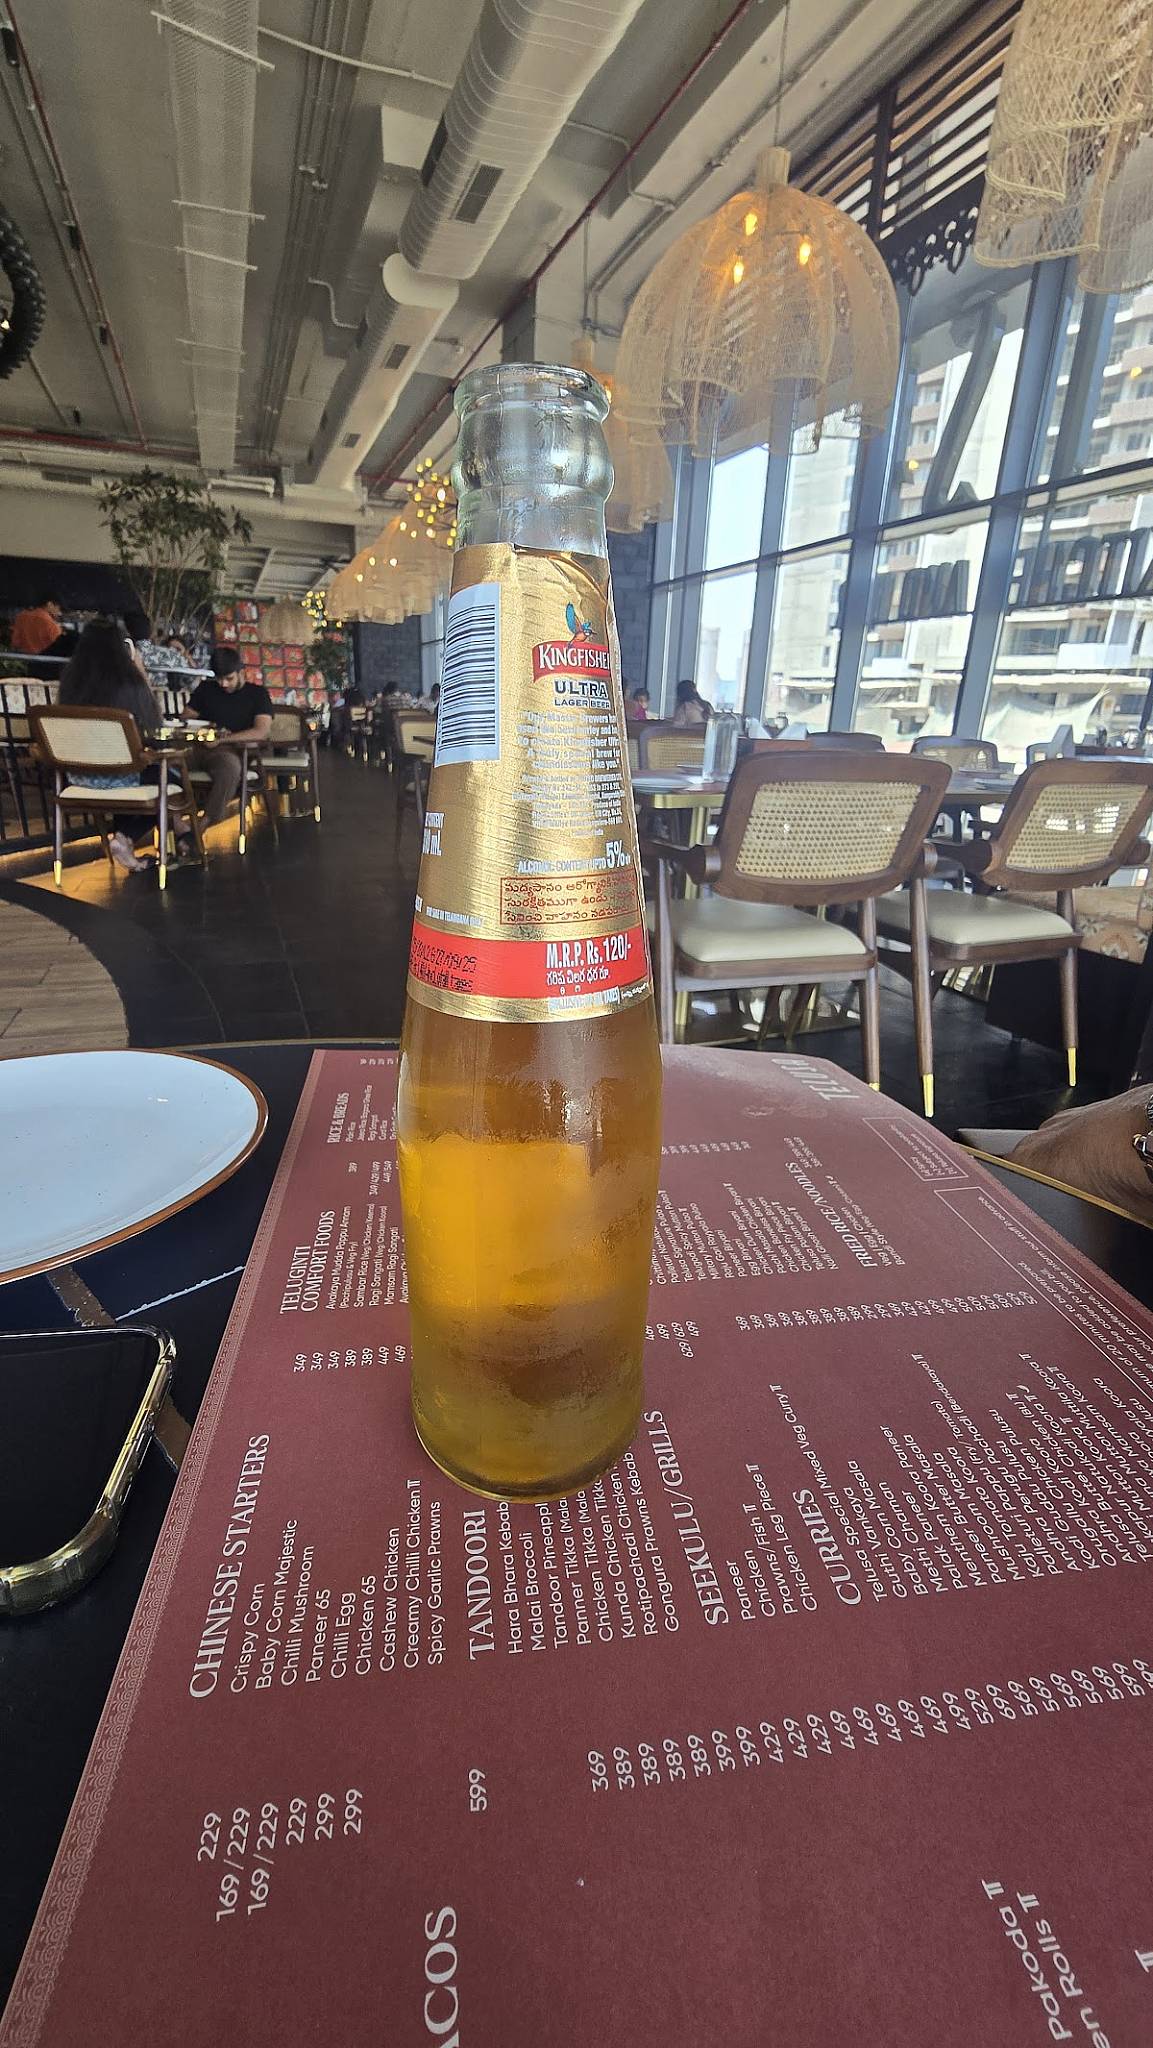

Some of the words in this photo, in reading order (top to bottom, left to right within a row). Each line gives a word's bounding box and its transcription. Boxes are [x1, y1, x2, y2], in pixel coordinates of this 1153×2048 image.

[554, 680, 608, 698] ULTRA
[554, 699, 588, 707] LAGER
[590, 700, 610, 709] BEER
[546, 942, 584, 968] M.R.P.
[586, 940, 603, 965] Rs.
[603, 933, 632, 961] 120/-
[331, 1118, 345, 1126] &
[332, 1092, 350, 1119] BREADS
[327, 1125, 343, 1144] RICE
[787, 1162, 851, 1233] RICE/NOODLES
[313, 1210, 336, 1248] FOODS
[841, 1234, 877, 1268] FRIED
[279, 1245, 312, 1315] TELUGINTI
[300, 1248, 329, 1312] COMFORT
[357, 1260, 369, 1276] Rice
[370, 1258, 385, 1288] Sangati
[353, 1276, 367, 1308] Sambar
[368, 1288, 383, 1307] Ragi
[901, 1301, 919, 1317] 429
[954, 1296, 974, 1313] 509
[1053, 1293, 1067, 1304] be
[1064, 1304, 1076, 1313] to
[671, 1322, 694, 1358] 629/629
[735, 1315, 751, 1331] 369
[791, 1310, 808, 1327] 389
[1074, 1313, 1110, 1344] minutes
[293, 1353, 308, 1373] 349
[310, 1352, 324, 1372] 349
[377, 1346, 390, 1365] 449
[1106, 1344, 1124, 1356] 20
[775, 1393, 797, 1423] Curry
[792, 1425, 810, 1449] Veg
[903, 1434, 940, 1480] Masala
[622, 1452, 644, 1496] Kebab
[802, 1450, 832, 1489] Mixed
[932, 1452, 972, 1500] Masala
[995, 1440, 1033, 1481] Pulusu
[752, 1473, 776, 1512] Piece
[847, 1460, 882, 1510] Masala
[933, 1482, 969, 1525] Butter
[1028, 1483, 1070, 1532] Guddu
[406, 1489, 421, 1549] Chicken
[427, 1501, 441, 1556] Prawns
[496, 1501, 513, 1551] Kebab
[534, 1501, 558, 1570] Pineappl
[636, 1498, 659, 1552] Prawns
[643, 1410, 729, 1626] SEEKULU/GRILLS
[769, 1514, 789, 1542] Leg
[823, 1492, 860, 1546] Special
[843, 1487, 882, 1551] Vankaya
[876, 1512, 902, 1549] Corn
[878, 1481, 919, 1544] Chaman
[901, 1490, 940, 1542] Paneer
[273, 1519, 298, 1586] Majestic
[383, 1527, 400, 1592] Chicken
[518, 1532, 540, 1597] Broccoli
[562, 1536, 580, 1579] Tikka
[582, 1526, 599, 1569] Tikka
[792, 1489, 862, 1605] CURRIES
[963, 1528, 1007, 1584] Paneer
[967, 1502, 1026, 1581] Mushroom
[1065, 1535, 1101, 1570] Kodi
[189, 1561, 243, 1698] CHINESE
[222, 1434, 270, 1557] STARTERS
[361, 1575, 377, 1596] 65
[405, 1551, 421, 1591] Chilli
[426, 1558, 442, 1610] Garlic
[463, 1509, 495, 1661] TANDOORI
[503, 1554, 519, 1604] Bhara
[744, 1549, 776, 1617] Chicken
[750, 1516, 799, 1614] Prawns/Fish
[783, 1544, 818, 1611] Chicken
[855, 1549, 888, 1603] Telusa
[874, 1553, 908, 1598] Guthi
[897, 1552, 929, 1595] Baby
[912, 1547, 949, 1593] Methi
[934, 1544, 969, 1590] Palak
[243, 1583, 266, 1626] Corn
[265, 1589, 287, 1633] Corn
[287, 1545, 315, 1634] Mushroom
[314, 1589, 331, 1610] 65
[335, 1592, 357, 1628] Egg
[548, 1573, 569, 1650] Tandoor
[591, 1570, 614, 1642] Chicken
[650, 1555, 680, 1632] Gongura
[726, 1560, 757, 1621] Paneer
[379, 1596, 398, 1672] Cashew
[403, 1595, 423, 1669] Creamy
[507, 1608, 524, 1654] Hara
[526, 1600, 547, 1651] Malai
[571, 1581, 592, 1645] Panner
[305, 1614, 328, 1683] Paneer
[330, 1632, 350, 1679] Chilli
[355, 1599, 375, 1675] Chicken
[427, 1614, 447, 1665] Spicy
[230, 1630, 259, 1693] Crispy
[255, 1637, 282, 1690] Baby
[280, 1638, 302, 1686] Chilli
[1112, 1662, 1146, 1697] 599
[942, 1691, 972, 1731] 499
[964, 1688, 995, 1725] 529
[985, 1684, 1017, 1720] 699
[1007, 1680, 1039, 1716] 569
[711, 1730, 736, 1772] 399
[759, 1721, 784, 1764] 429
[829, 1710, 856, 1750] 469
[468, 1768, 488, 1812] 599
[587, 1750, 609, 1793] 369
[612, 1746, 636, 1791] 389
[197, 1812, 222, 1862] 229
[226, 1807, 251, 1857] 229
[285, 1797, 308, 1846] 229
[314, 1793, 336, 1841] 299
[223, 1858, 245, 1871] /
[216, 1873, 240, 1922] 169
[999, 1905, 1073, 2041] Pakoda
[1035, 1918, 1084, 1998] Rolls
